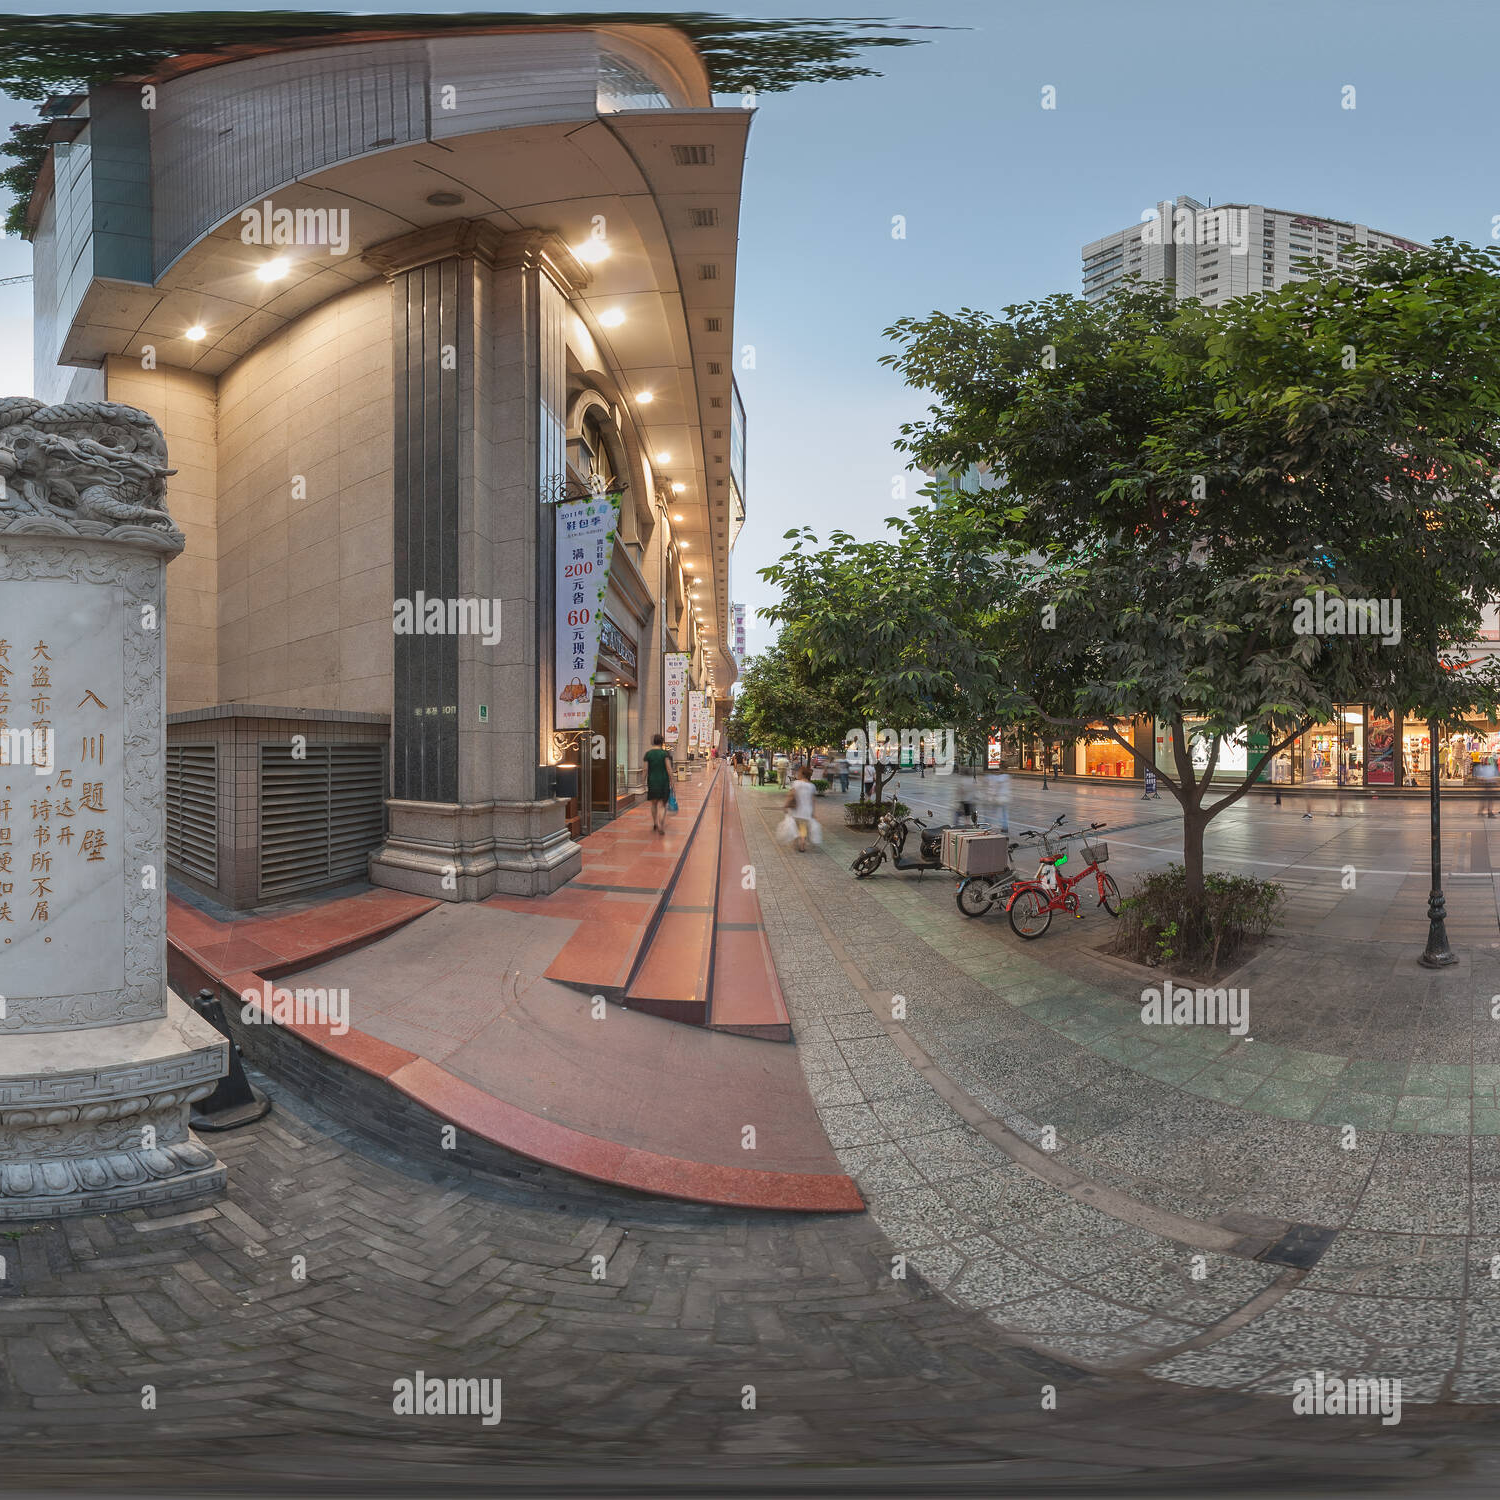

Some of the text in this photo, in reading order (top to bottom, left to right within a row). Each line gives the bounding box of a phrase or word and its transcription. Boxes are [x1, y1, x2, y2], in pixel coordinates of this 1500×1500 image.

[566, 516, 602, 531] 鞋包季
[55, 769, 76, 847] 石达开
[77, 689, 110, 864] 入川题壁
